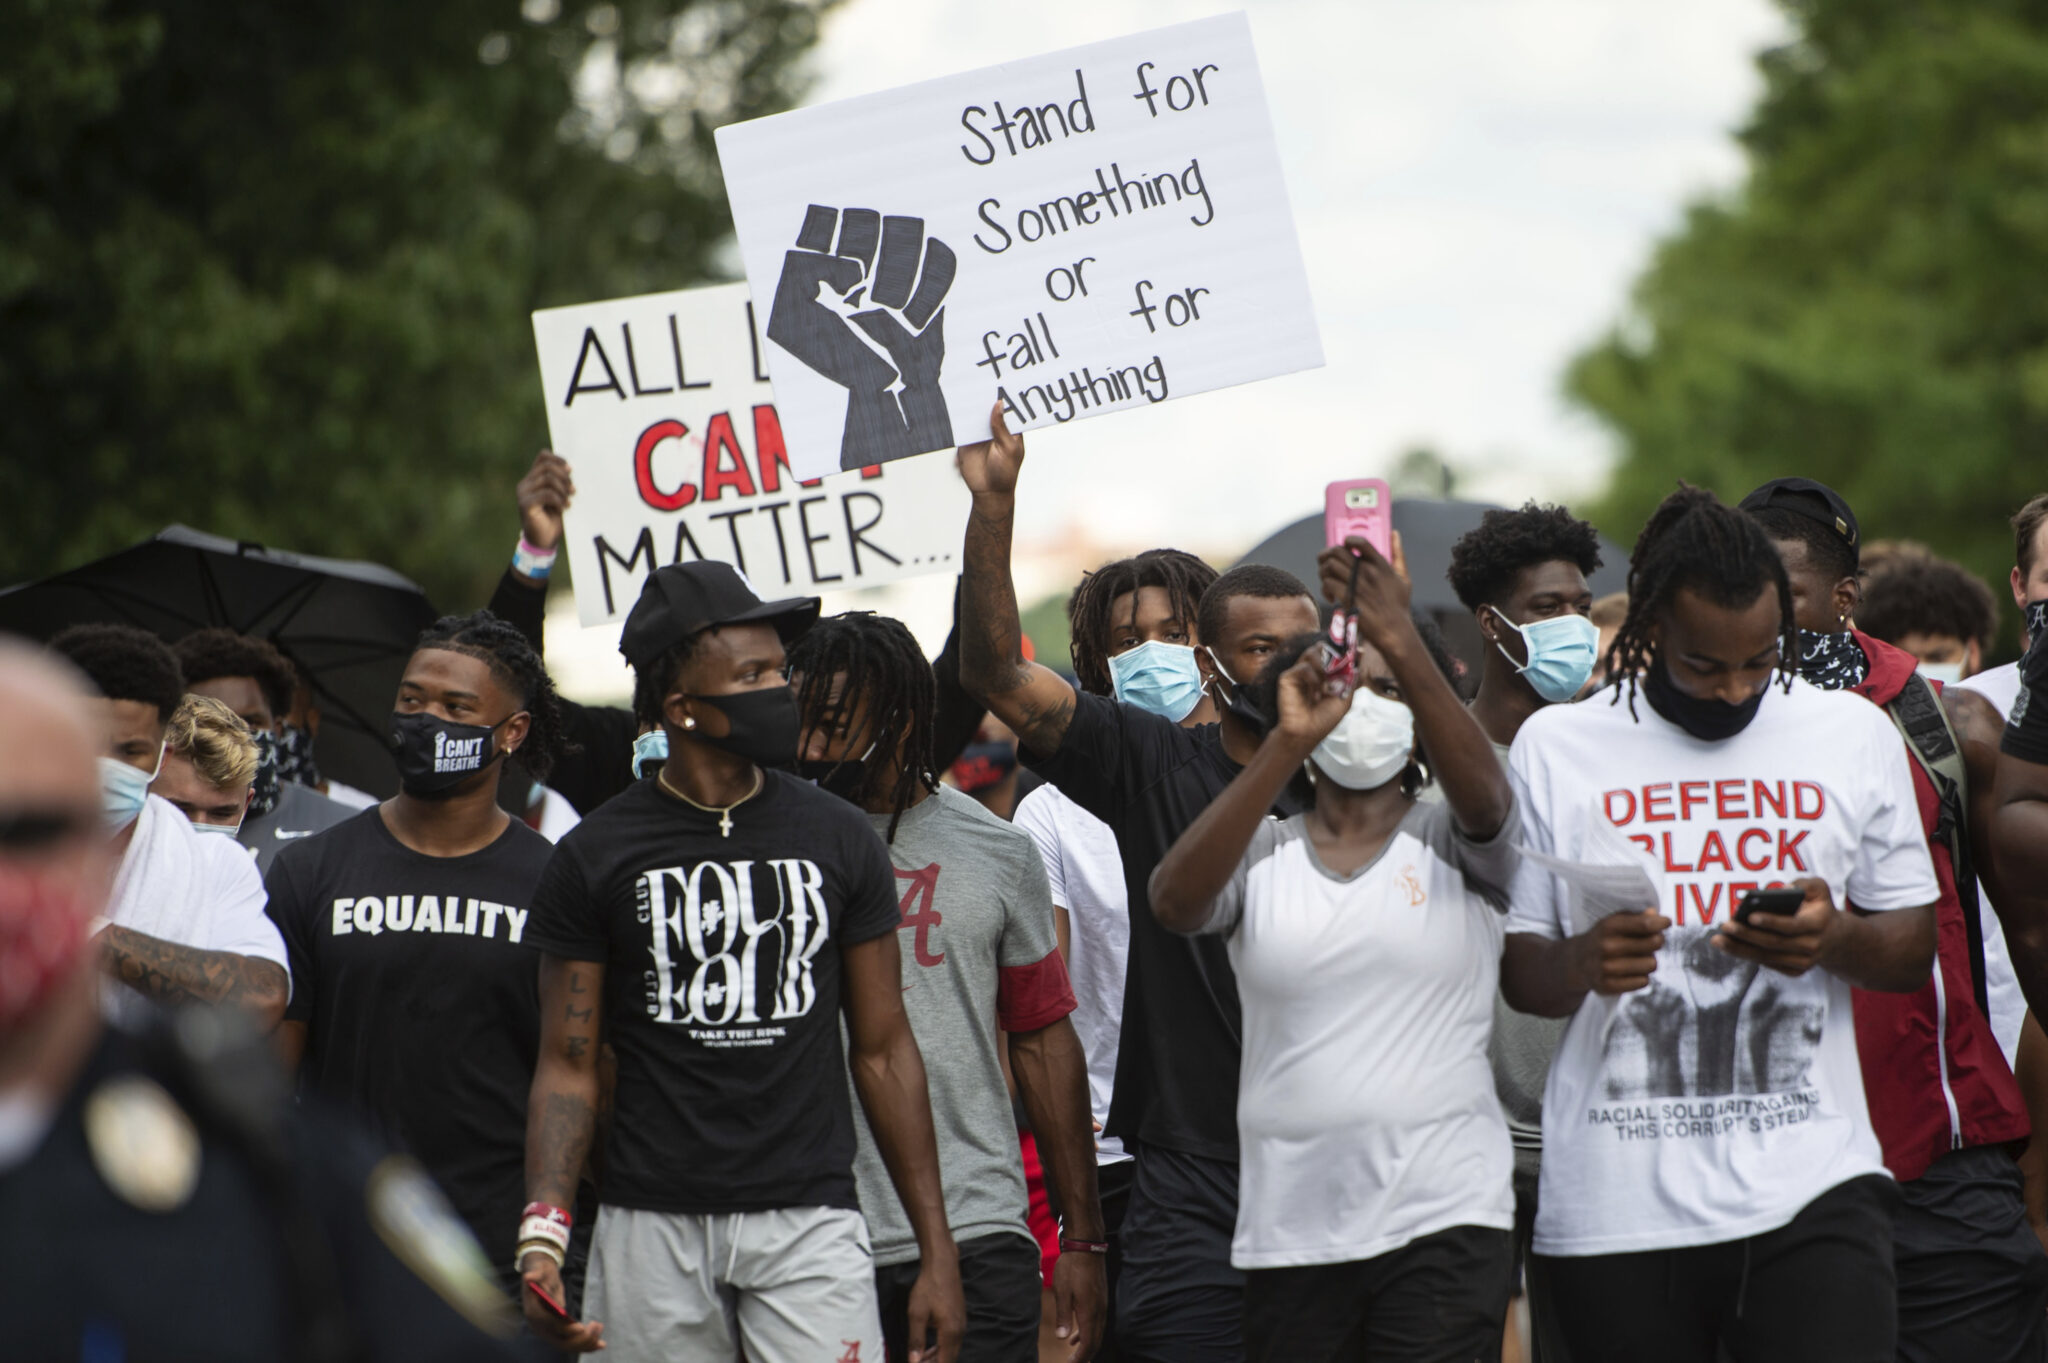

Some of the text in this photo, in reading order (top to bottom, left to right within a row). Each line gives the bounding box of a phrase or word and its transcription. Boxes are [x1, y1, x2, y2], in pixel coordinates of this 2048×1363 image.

[961, 62, 1219, 165] Stand for
[973, 159, 1214, 254] Something
[1045, 256, 1096, 301] or
[976, 280, 1210, 379] fall for
[564, 314, 711, 407] ALL
[997, 356, 1168, 424] Anything
[434, 755, 481, 773] BREATHE
[1603, 779, 1825, 827] DEFEND
[332, 895, 528, 943] EQUALITY
[635, 876, 651, 924] CLUB
[688, 1029, 726, 1040] TAKE
[727, 1029, 755, 1039] THE
[1588, 1107, 1657, 1125] RACIAL
[1757, 1090, 1820, 1113] AGAINS
[1615, 1106, 1811, 1141] THIS CORRUPT SSTEM
